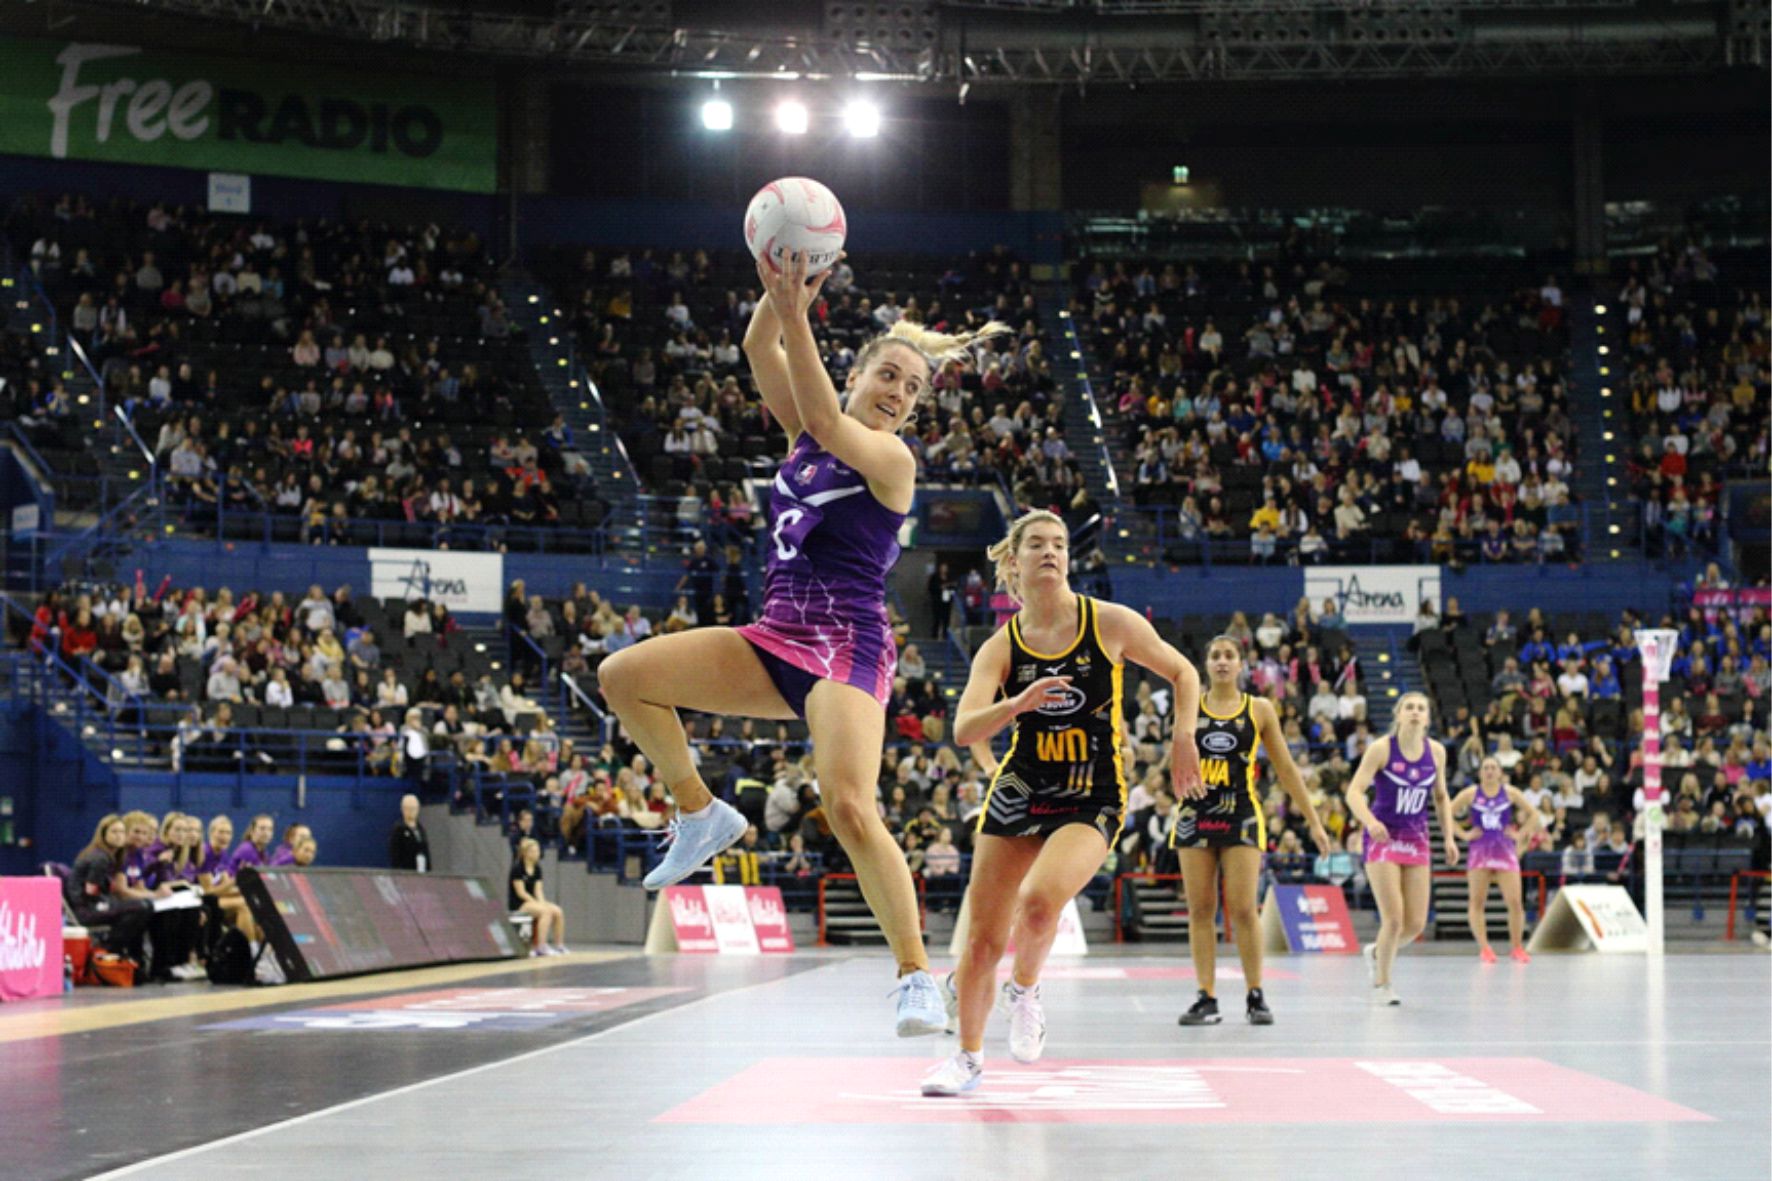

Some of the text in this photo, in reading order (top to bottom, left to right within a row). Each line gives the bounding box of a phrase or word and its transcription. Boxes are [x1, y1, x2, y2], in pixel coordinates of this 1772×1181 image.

[47, 42, 444, 159] Free RADIO
[772, 508, 804, 561] C
[398, 557, 468, 600] Arena
[1335, 573, 1406, 610] Arena
[1200, 758, 1230, 786] WA
[1395, 788, 1428, 815] WD
